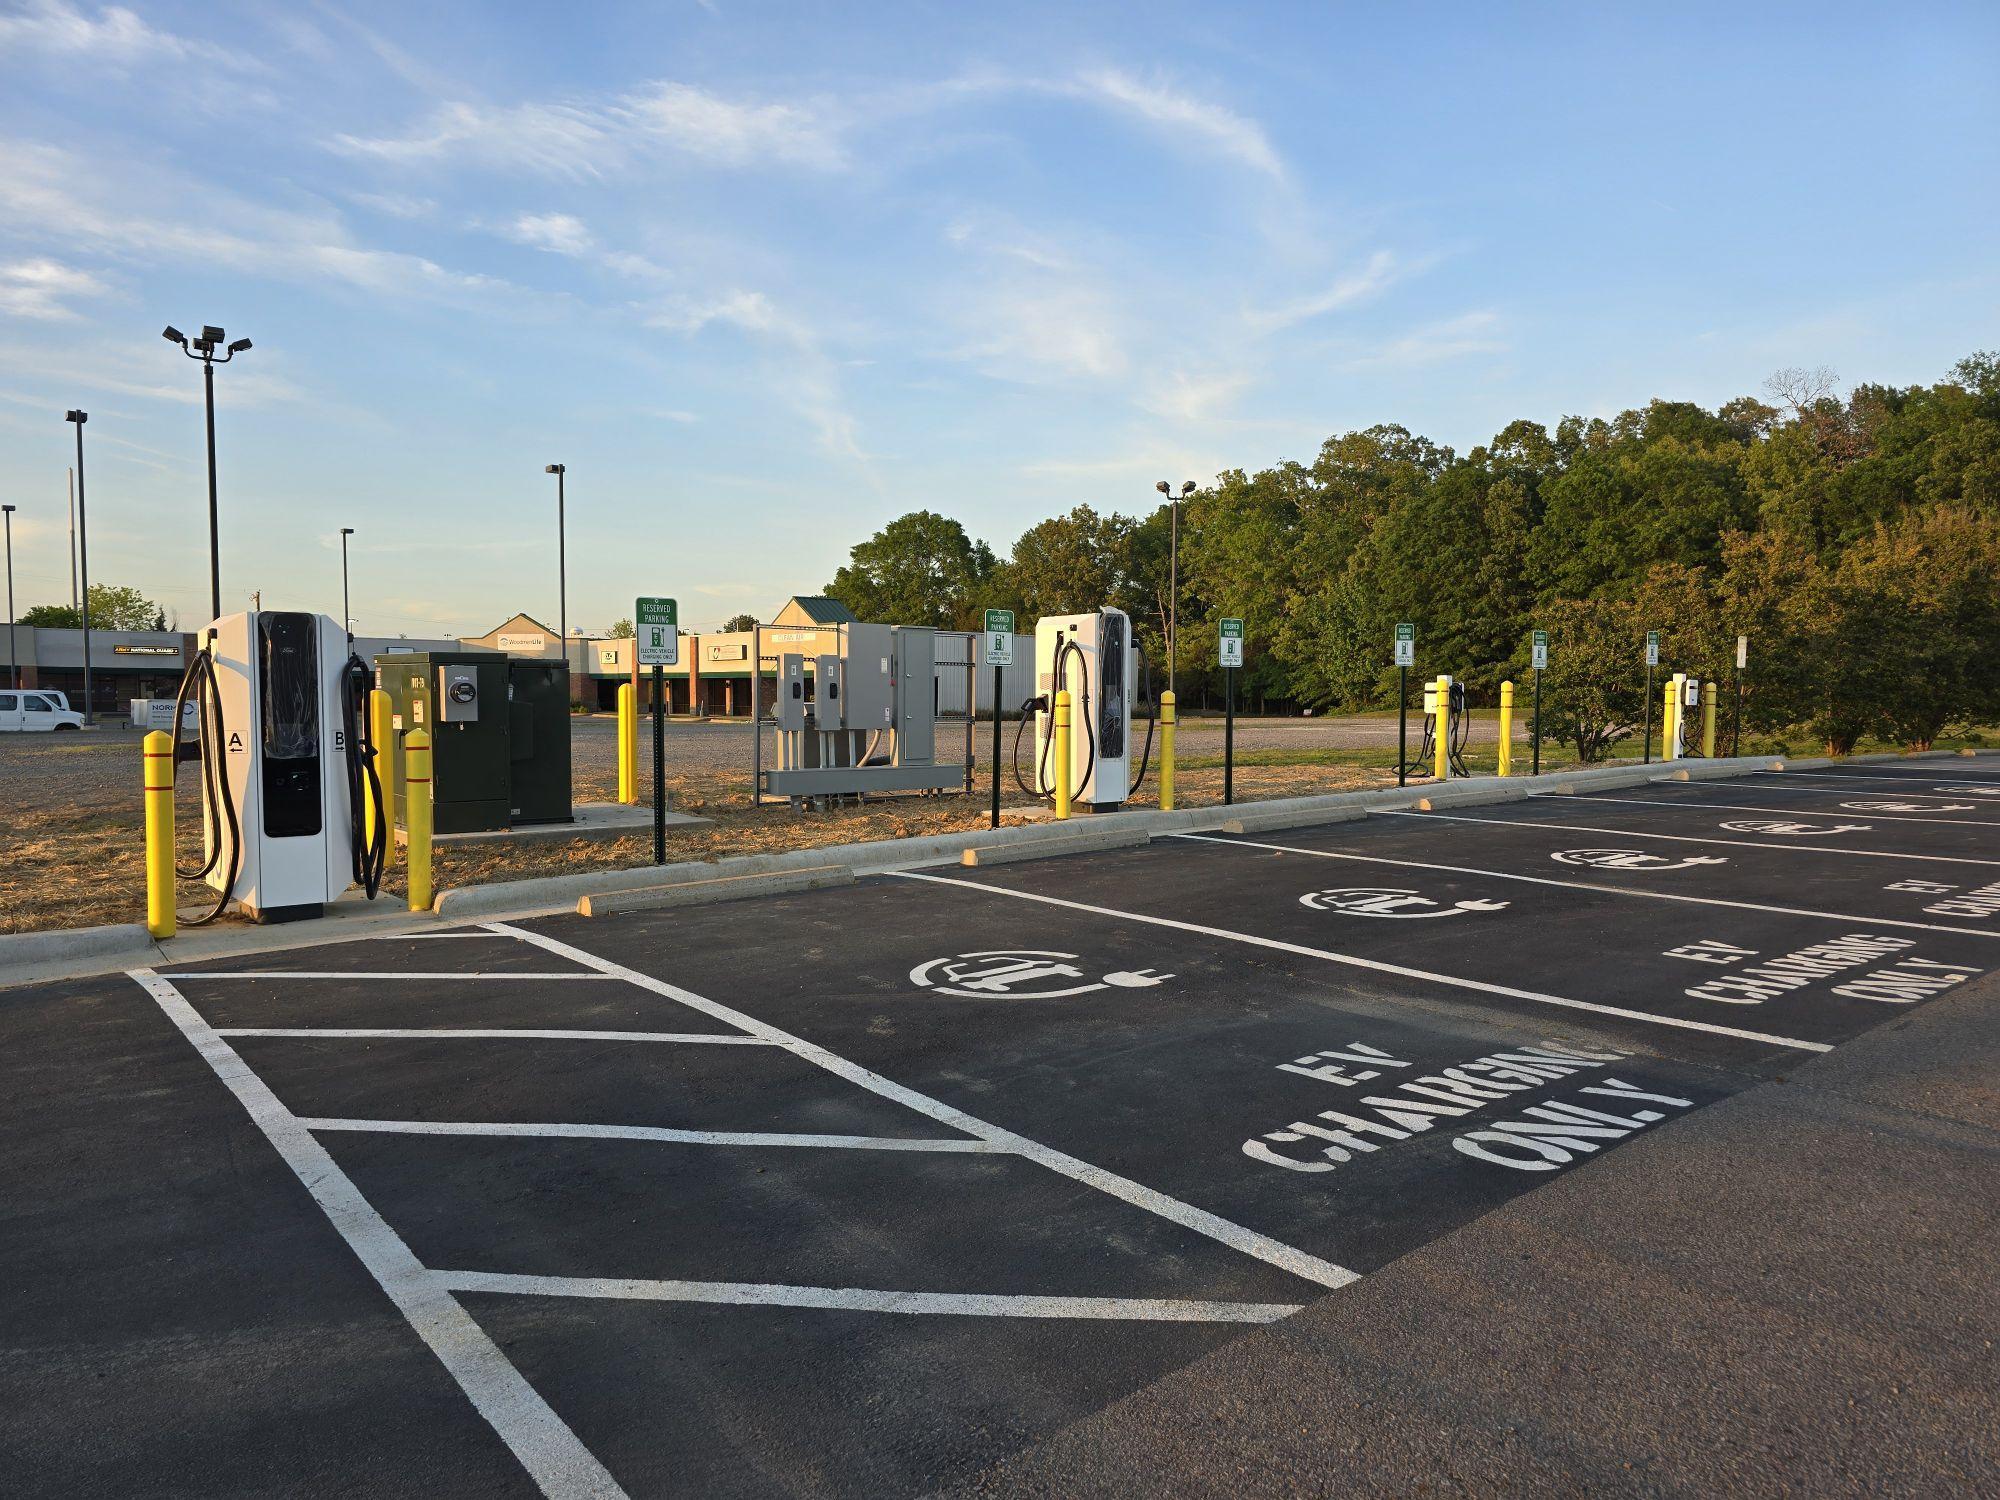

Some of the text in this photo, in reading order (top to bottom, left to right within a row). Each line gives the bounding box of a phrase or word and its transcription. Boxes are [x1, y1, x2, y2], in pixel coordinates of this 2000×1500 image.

[642, 604, 671, 613] RESERVED
[644, 614, 669, 624] PARKING
[228, 732, 243, 747] A
[335, 732, 345, 745] B
[1882, 879, 1959, 894] EV
[1662, 939, 1760, 965] EV
[1684, 934, 1917, 1004] CHARGING
[1831, 956, 1984, 1004] ONLY
[1275, 1042, 1413, 1087] EV
[1452, 1077, 1695, 1171] ONLY
